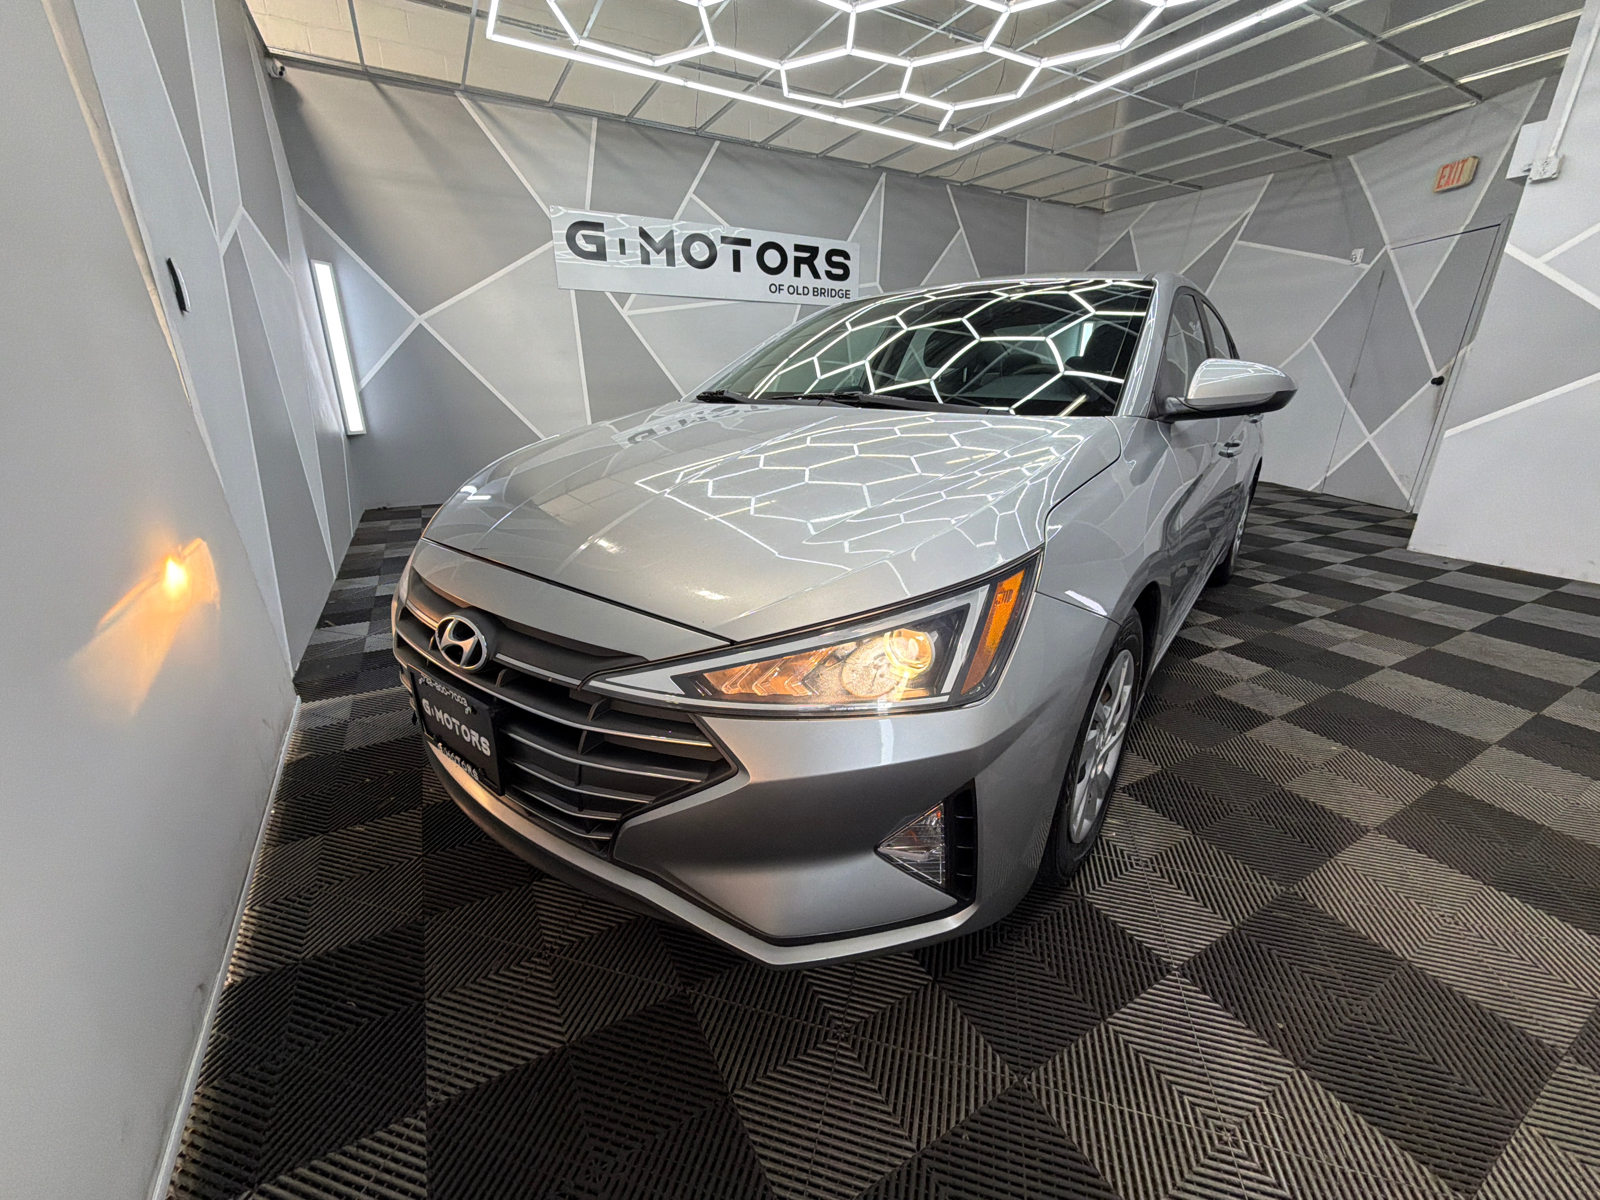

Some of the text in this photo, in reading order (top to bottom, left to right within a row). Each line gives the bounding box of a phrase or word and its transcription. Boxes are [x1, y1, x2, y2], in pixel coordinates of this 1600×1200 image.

[1436, 158, 1469, 190] EXIT
[768, 282, 851, 300] OF OLD BRIDGE
